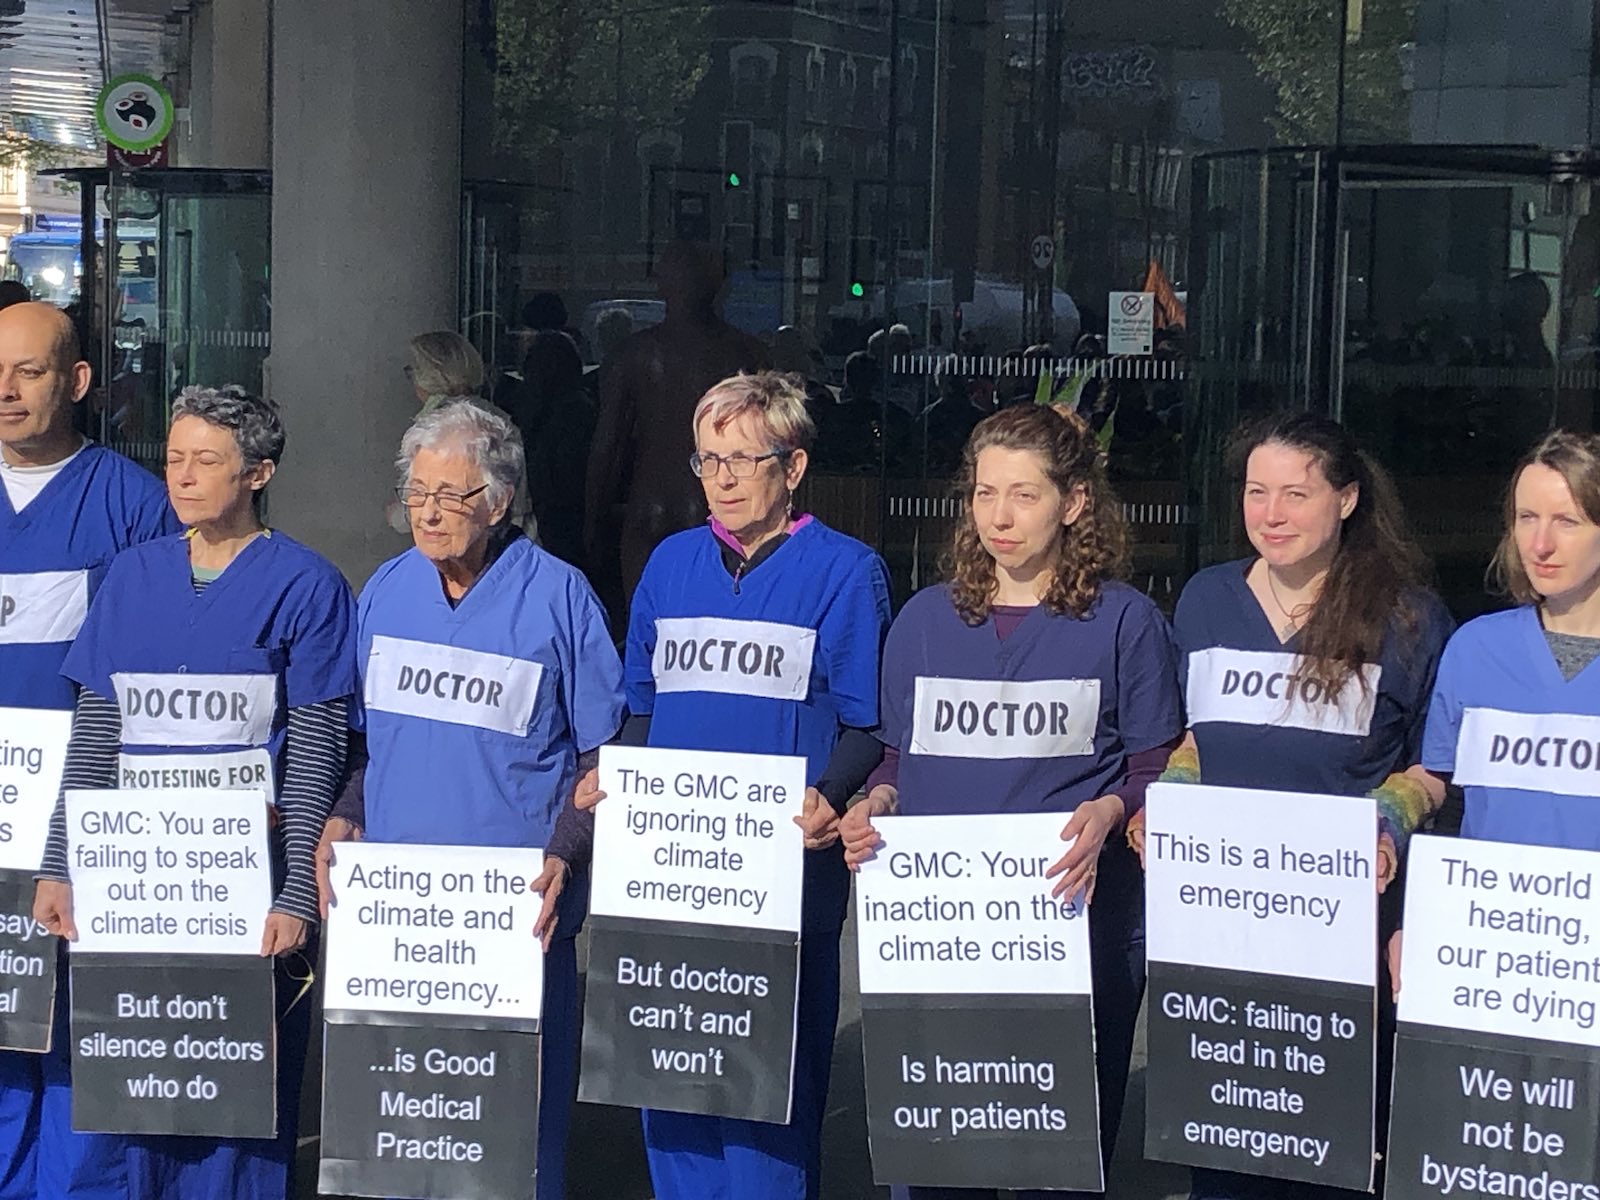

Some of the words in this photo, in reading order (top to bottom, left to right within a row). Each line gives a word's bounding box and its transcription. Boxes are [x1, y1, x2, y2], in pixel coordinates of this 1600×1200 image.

[664, 639, 784, 678] DOCTOR
[398, 666, 503, 707] DOCTOR
[127, 687, 248, 721] DOCTOR
[935, 700, 1068, 736] DOCTOR
[0, 740, 42, 774] ing
[123, 768, 221, 788] PROTESTING
[229, 764, 265, 785] FOR
[617, 769, 664, 795] The
[674, 773, 738, 800] GMC
[747, 784, 786, 804] are
[0, 785, 18, 804] e
[81, 811, 150, 834] GMC:
[159, 811, 203, 835] You
[213, 818, 250, 835] are
[627, 804, 726, 841] ignoring
[736, 812, 773, 838] the
[76, 844, 146, 874] failing
[155, 846, 177, 868] to
[186, 846, 258, 874] speak
[654, 842, 743, 871] climate
[890, 852, 971, 878] GMC:
[981, 851, 1048, 877] Your
[1151, 832, 1210, 863] This
[1221, 838, 1242, 866] is
[1253, 849, 1269, 869] a
[1281, 844, 1369, 879] health
[108, 879, 146, 901] out
[154, 884, 182, 901] on
[191, 879, 228, 902] the
[347, 864, 431, 897] Acting
[441, 873, 473, 892] on
[484, 869, 525, 895] the
[1441, 858, 1498, 889] The
[1509, 871, 1591, 899] world
[627, 880, 767, 915] emergency
[865, 895, 974, 921] inaction
[986, 901, 1020, 920] on
[1030, 894, 1076, 920] the
[1180, 885, 1340, 926] emergency
[91, 911, 177, 935] climate
[186, 912, 247, 936] crisis
[359, 900, 454, 928] climate
[464, 906, 513, 930] and
[1469, 900, 1589, 945] heating,
[395, 937, 475, 965] health
[879, 935, 980, 961] climate
[992, 934, 1066, 961] crisis
[1438, 945, 1487, 968] our
[1496, 951, 1600, 983] patient
[347, 977, 519, 1008] emergency...
[618, 958, 663, 987] But
[670, 963, 768, 997] doctors
[118, 994, 160, 1018] But
[166, 995, 227, 1020] don't
[630, 1004, 693, 1031] can't
[701, 1010, 750, 1036] and
[1163, 992, 1236, 1024] GMC:
[1244, 1001, 1321, 1041] failing
[1330, 1013, 1355, 1038] to
[1454, 986, 1501, 1010] are
[1513, 987, 1595, 1029] dying
[80, 1033, 166, 1058] silence
[174, 1035, 264, 1061] doctors
[370, 1047, 416, 1072] ...is
[424, 1049, 495, 1076] Good
[652, 1048, 723, 1075] won't
[1191, 1034, 1244, 1064] lead
[1254, 1041, 1275, 1068] in
[1284, 1046, 1325, 1074] the
[127, 1073, 179, 1098] who
[186, 1075, 217, 1099] do
[903, 1055, 925, 1082] Is
[936, 1055, 1054, 1091] harming
[1460, 1066, 1512, 1100] We
[1523, 1078, 1574, 1109] will
[381, 1091, 480, 1120] Medical
[1211, 1079, 1303, 1113] climate
[895, 1107, 941, 1128] our
[951, 1102, 1066, 1135] patients
[377, 1132, 482, 1162] Practice
[1184, 1122, 1329, 1166] emergency
[1463, 1122, 1513, 1150] not
[1523, 1123, 1563, 1156] be
[1423, 1155, 1599, 1200] bystanders
